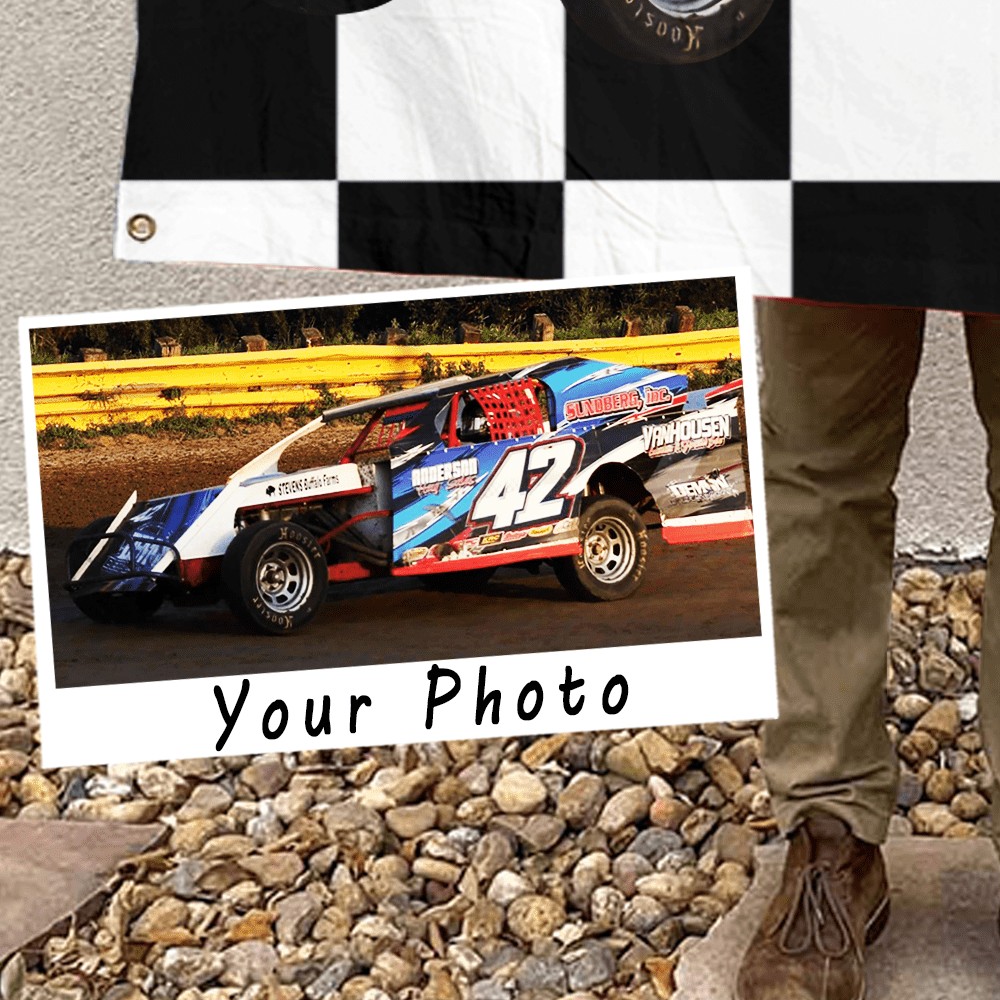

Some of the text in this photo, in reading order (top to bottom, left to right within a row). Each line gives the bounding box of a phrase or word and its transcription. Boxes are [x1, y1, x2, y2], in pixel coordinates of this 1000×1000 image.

[642, 414, 731, 451] VANHOUSEN
[278, 481, 304, 496] STEVENS
[468, 436, 580, 532] 42
